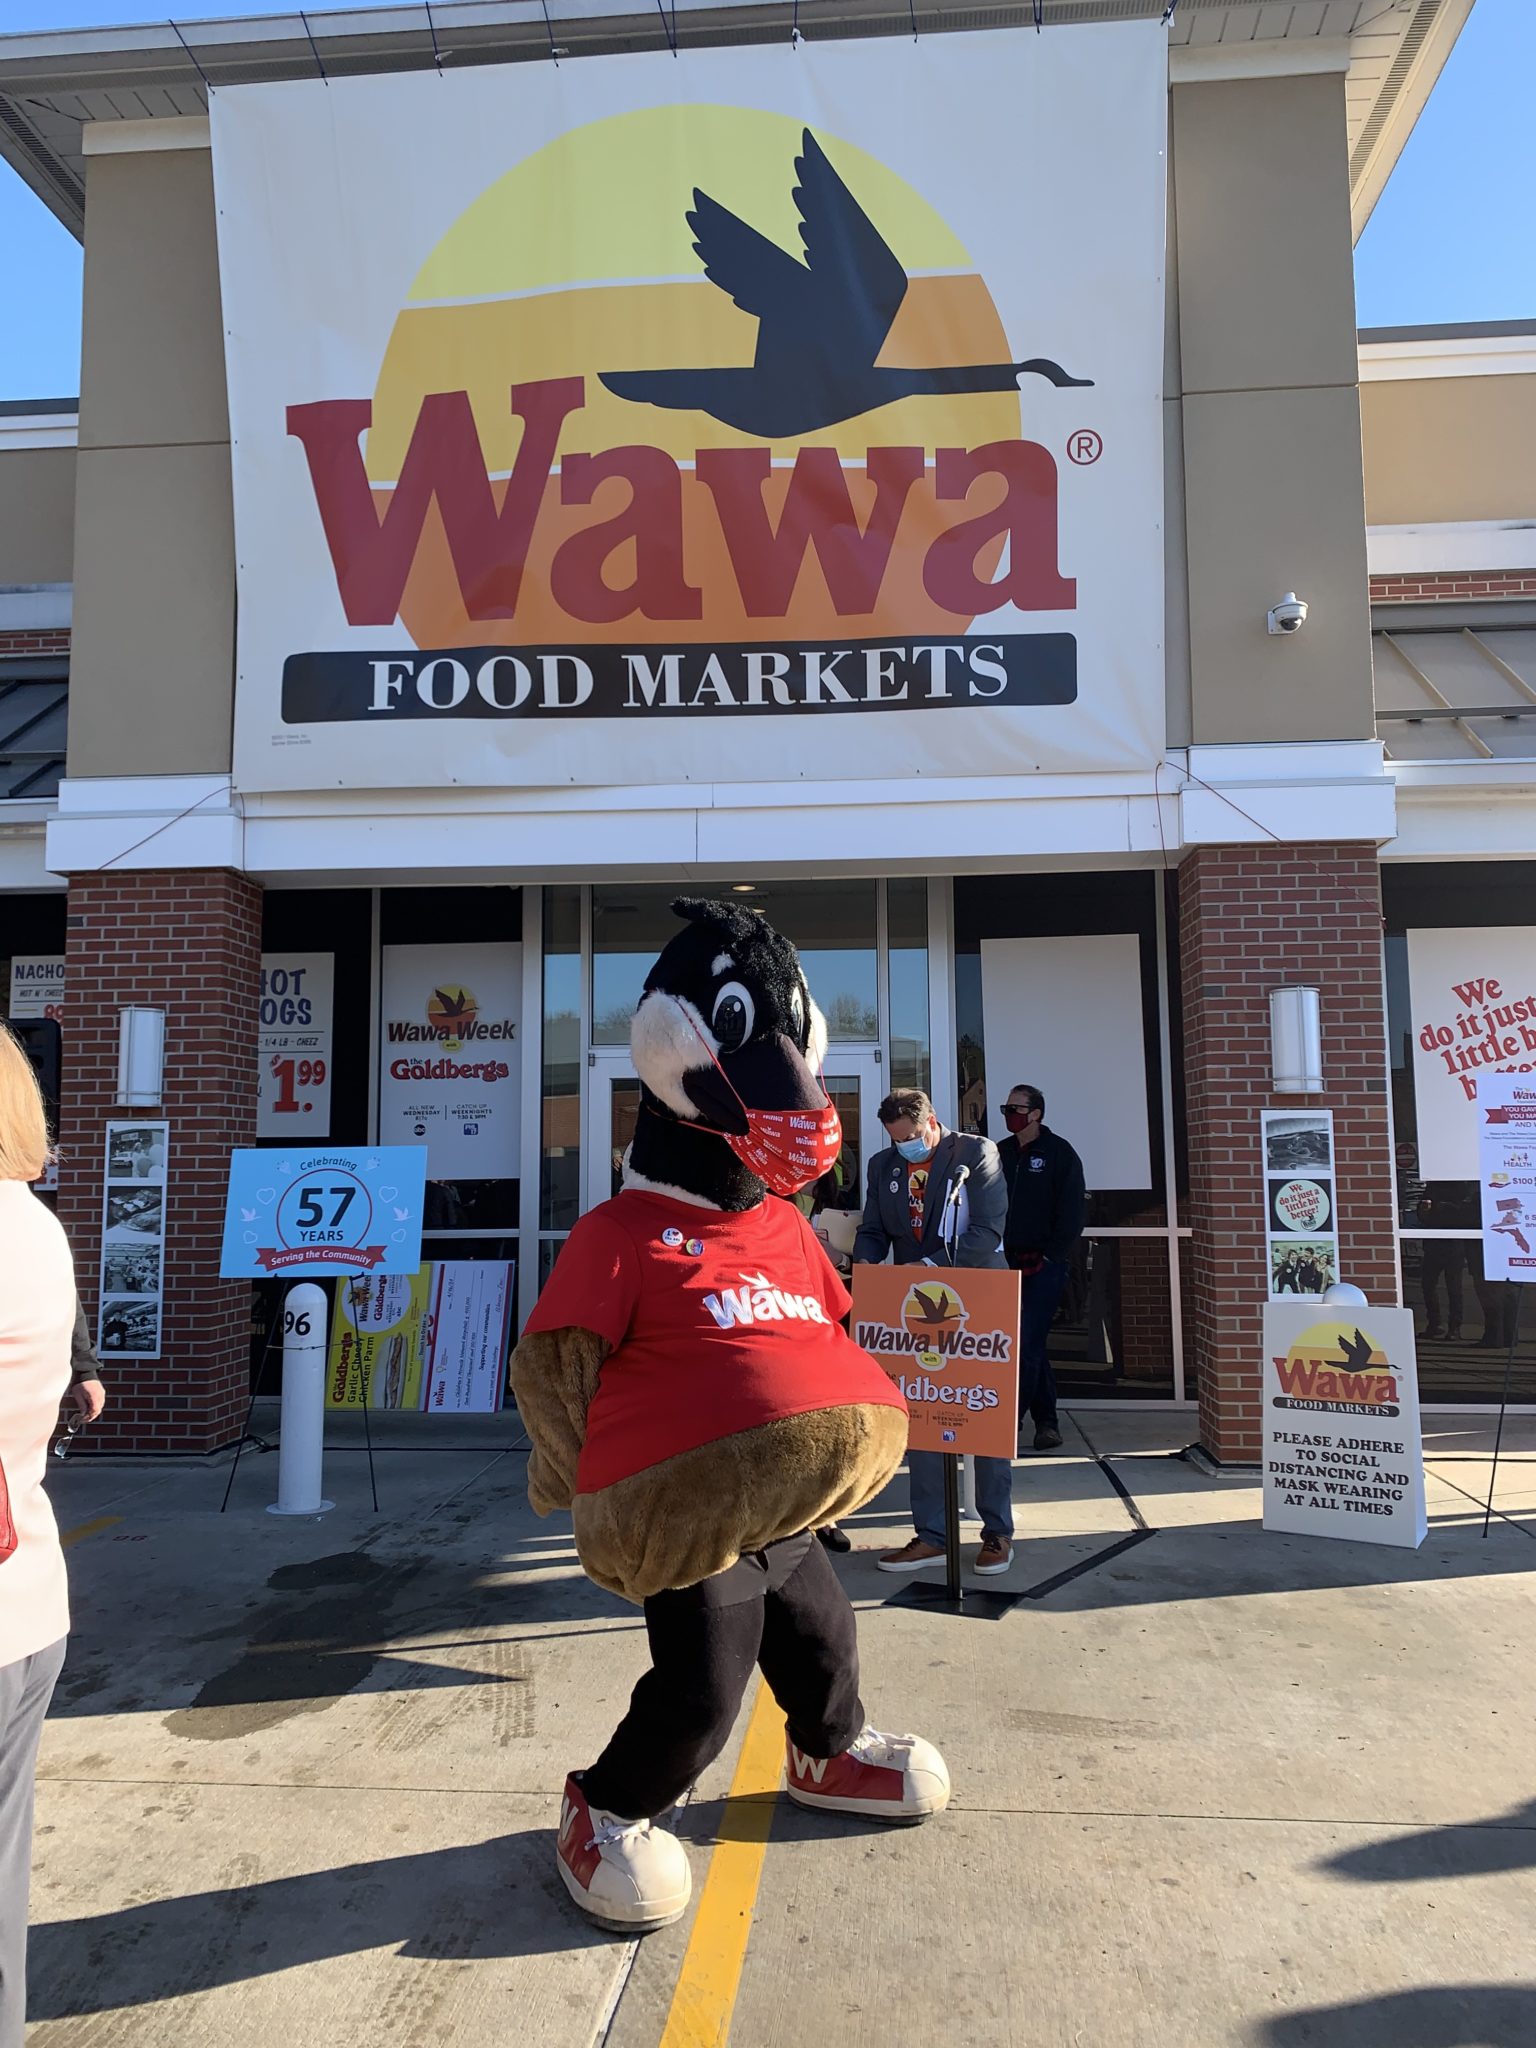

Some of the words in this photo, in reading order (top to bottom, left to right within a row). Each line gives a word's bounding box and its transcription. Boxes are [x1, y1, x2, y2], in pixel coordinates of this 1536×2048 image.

[286, 376, 1077, 626] Wawa
[368, 655, 594, 711] FOOD
[621, 645, 1008, 709] MARKETS
[1451, 978, 1503, 1008] We
[260, 998, 312, 1025] OGS
[1420, 1024, 1454, 1051] do
[1456, 1013, 1483, 1039] it
[1483, 996, 1536, 1040] just
[265, 1038, 277, 1046] 1/4
[279, 1037, 288, 1046] LB
[296, 1037, 319, 1046] CHEEZ
[388, 1022, 450, 1042] Wawa
[457, 1020, 516, 1041] Week
[1441, 1034, 1520, 1075] little
[390, 1058, 509, 1082] Goldbergs
[1513, 1091, 1536, 1100] Waw
[789, 1116, 817, 1130] Wawa
[795, 1136, 818, 1146] Wawa
[300, 1157, 358, 1172] Celebrating
[788, 1151, 817, 1167] Wawa
[1279, 1197, 1290, 1205] do
[1290, 1194, 1297, 1203] it
[1297, 1190, 1314, 1201] just
[1289, 1184, 1303, 1193] We
[296, 1187, 357, 1227] 57
[1285, 1200, 1307, 1212] little
[1308, 1197, 1320, 1206] bit
[1290, 1206, 1319, 1220] better!
[300, 1230, 343, 1242] YEARS
[271, 1251, 304, 1266] Serving
[306, 1250, 320, 1258] the
[322, 1250, 371, 1265] Community
[363, 1275, 372, 1295] Wee
[703, 1282, 832, 1330] Wawa
[284, 1311, 311, 1336] 96
[363, 1336, 374, 1361] Parm
[858, 1324, 931, 1353] Wawa
[937, 1330, 1009, 1360] Week
[347, 1374, 359, 1403] Garlic
[359, 1363, 371, 1403] Chicken
[1272, 1357, 1400, 1403] Wawa
[434, 1380, 446, 1407] Wawa
[898, 1374, 999, 1411] ldbergs
[1286, 1399, 1323, 1411] FOOD
[1327, 1402, 1390, 1416] MARKETS
[1273, 1431, 1332, 1447] PLEASE
[1336, 1437, 1404, 1454] ADHERE
[1296, 1449, 1316, 1461] TO
[1321, 1452, 1380, 1467] SOCIAL
[1269, 1461, 1368, 1482] DISTANCING
[1372, 1471, 1409, 1486] AND
[1274, 1477, 1319, 1492] MASK
[1324, 1482, 1403, 1501] WEARING
[1284, 1493, 1304, 1506] AT
[1309, 1496, 1339, 1510] ALL
[1343, 1500, 1393, 1516] TIMES
[792, 1744, 829, 1784] W
